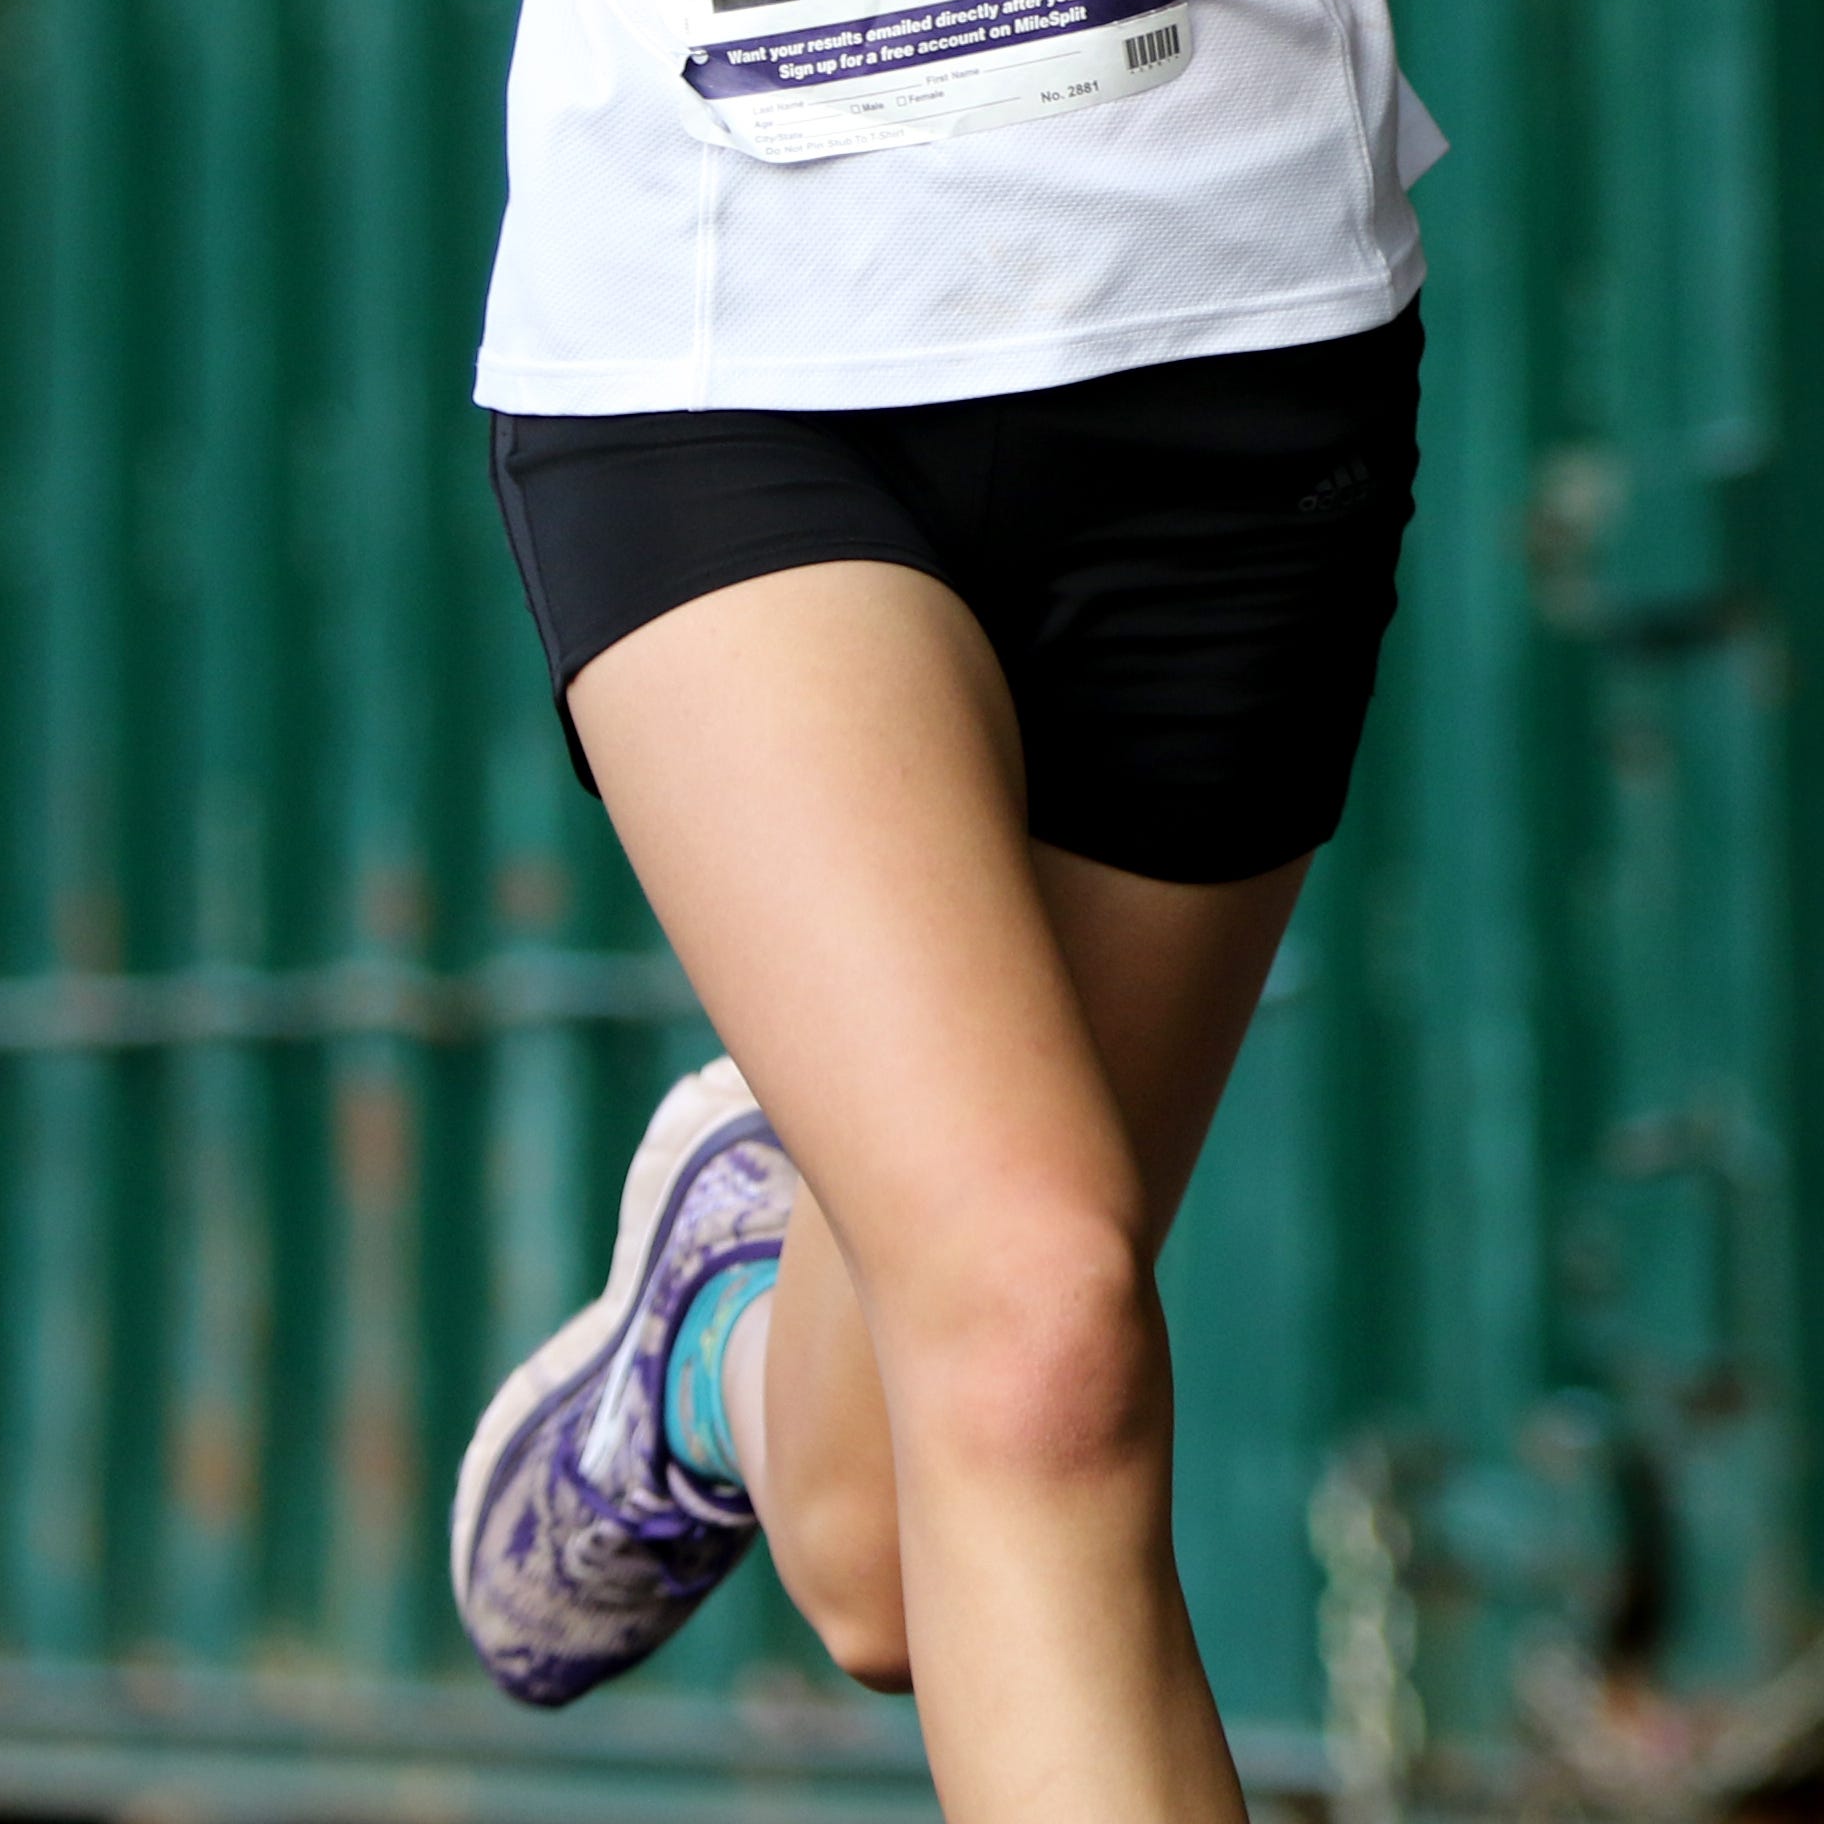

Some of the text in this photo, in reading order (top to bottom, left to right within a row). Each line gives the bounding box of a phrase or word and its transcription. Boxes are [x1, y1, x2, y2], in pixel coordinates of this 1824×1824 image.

[726, 48, 767, 65] Want
[769, 42, 805, 62] your
[807, 31, 863, 53] results
[865, 16, 932, 42] emailed
[935, 2, 999, 28] directly
[778, 6, 1087, 80] Sign up for a free account on MileSplit
[926, 72, 949, 86] First
[952, 66, 980, 81] Name
[862, 102, 885, 113] Male
[908, 88, 945, 105] Female
[1040, 79, 1100, 104] No. 2881
[784, 142, 804, 154] Not
[806, 140, 824, 151] Pin
